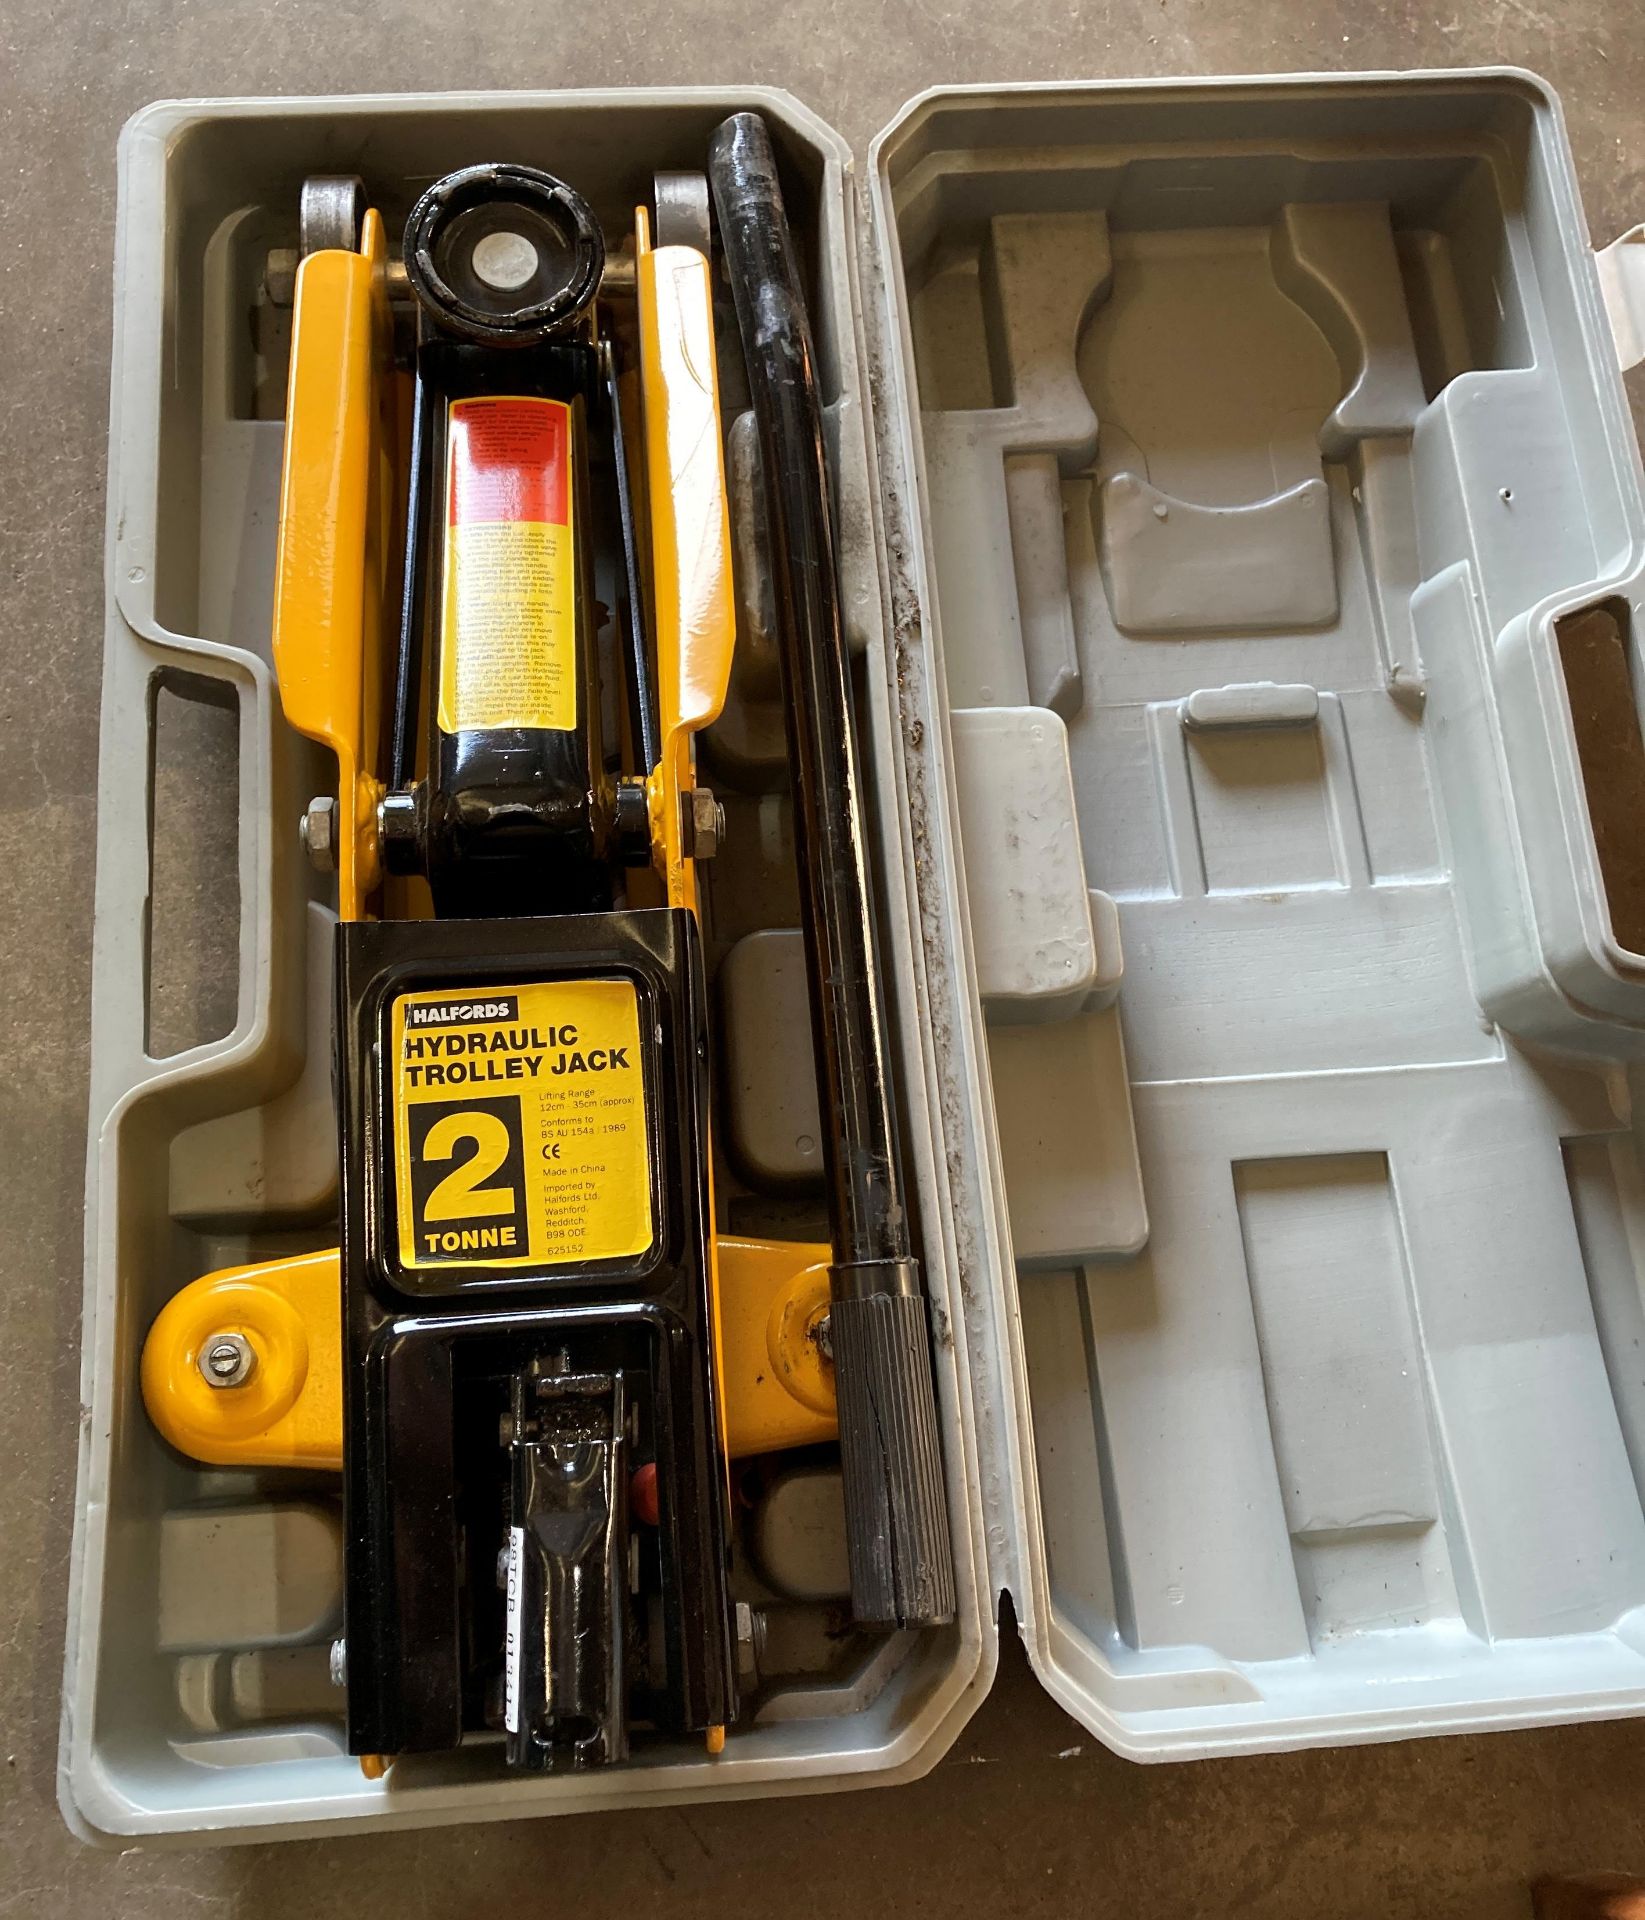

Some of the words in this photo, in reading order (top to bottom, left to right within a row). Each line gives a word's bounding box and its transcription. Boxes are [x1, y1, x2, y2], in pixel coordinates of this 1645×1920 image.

[413, 1003, 509, 1024] HALFORDS
[405, 1025, 578, 1060] HYDRAULIC
[405, 1055, 544, 1087] TROLLEY
[551, 1047, 630, 1076] JACK
[539, 1092, 566, 1101] Lifting
[568, 1089, 595, 1099] Range
[541, 1103, 565, 1112] 12cm
[572, 1099, 597, 1109] 35cm
[599, 1096, 635, 1107] (approx)
[540, 1117, 583, 1128] Conforms
[585, 1115, 594, 1124] to
[541, 1129, 554, 1139] BS
[557, 1128, 568, 1137] AU
[570, 1127, 595, 1137] 154a
[602, 1123, 626, 1134] 1989
[541, 1142, 561, 1160] CE
[423, 1111, 515, 1222] 2
[542, 1167, 567, 1177] Made
[570, 1167, 578, 1175] in
[580, 1164, 606, 1174] China
[543, 1182, 583, 1193] Imported
[585, 1181, 596, 1190] by
[544, 1194, 581, 1204] Halfords
[425, 1226, 517, 1253] TONNE
[546, 1230, 566, 1240] B98
[547, 1243, 584, 1256] 625152
